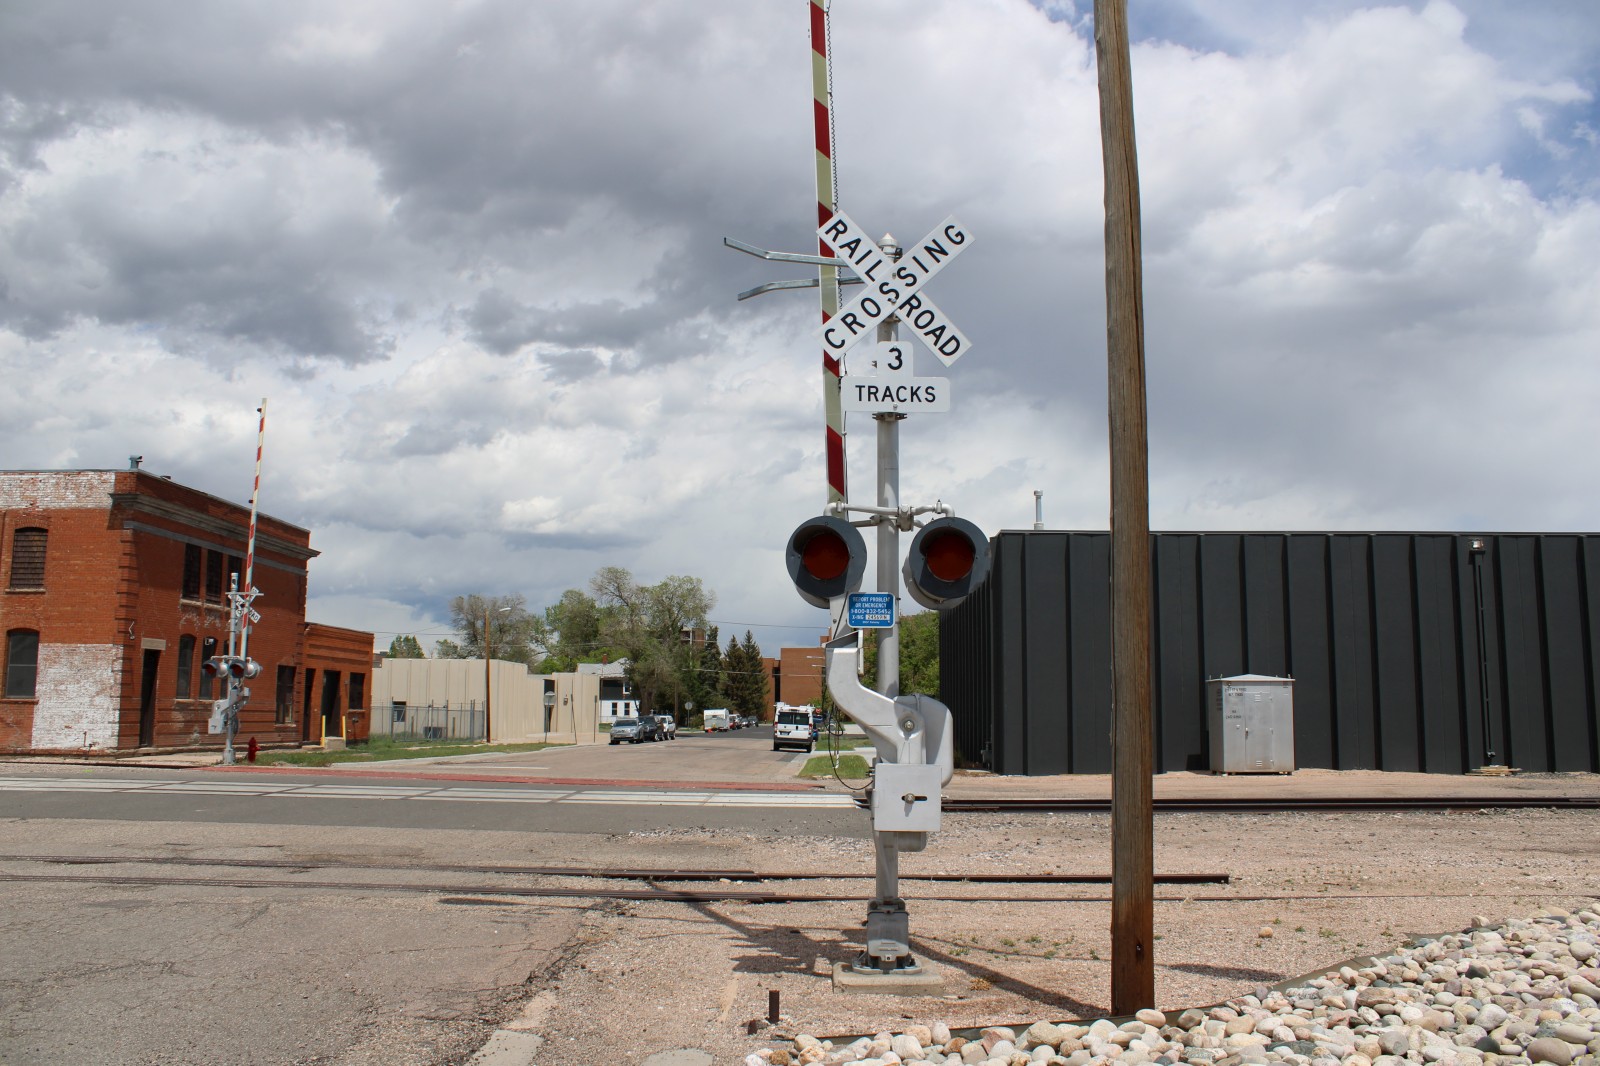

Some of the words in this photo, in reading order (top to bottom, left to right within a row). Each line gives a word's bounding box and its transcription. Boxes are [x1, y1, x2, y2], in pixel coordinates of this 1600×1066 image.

[824, 224, 965, 349] CROSSING
[824, 218, 883, 282] RAIL
[898, 294, 960, 357] ROAD
[855, 385, 936, 403] TRACKS
[887, 347, 903, 371] 3
